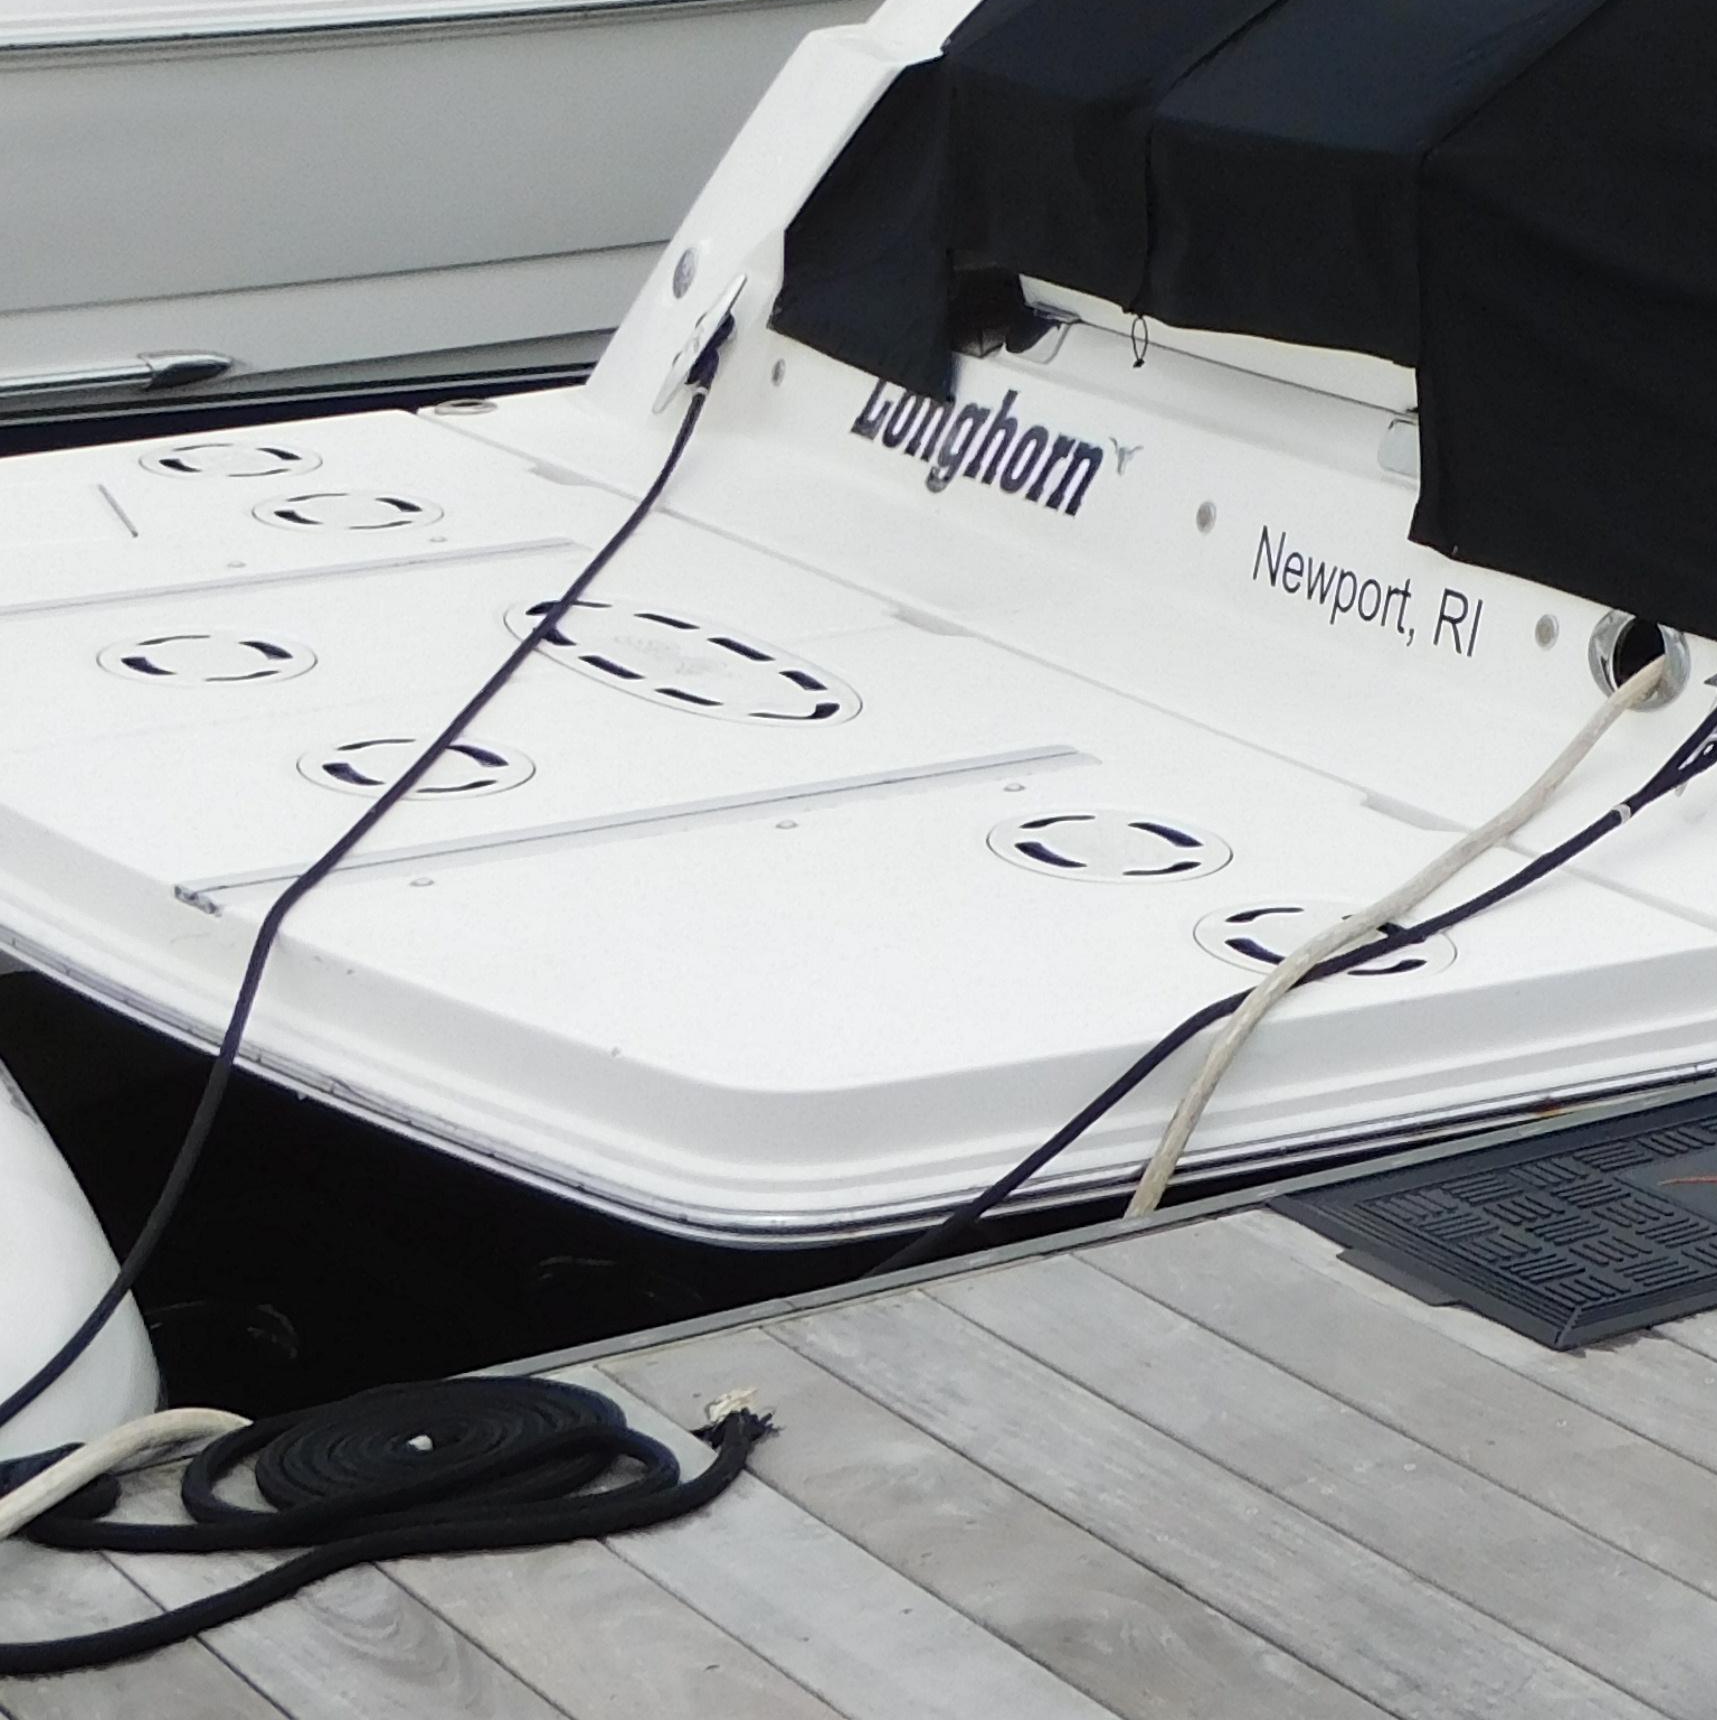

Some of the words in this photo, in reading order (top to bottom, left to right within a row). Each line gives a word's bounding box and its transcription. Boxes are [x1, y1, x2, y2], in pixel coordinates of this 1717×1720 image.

[850, 377, 1104, 518] Longhorn
[1252, 525, 1415, 648] Newport,
[1433, 587, 1484, 658] RI
